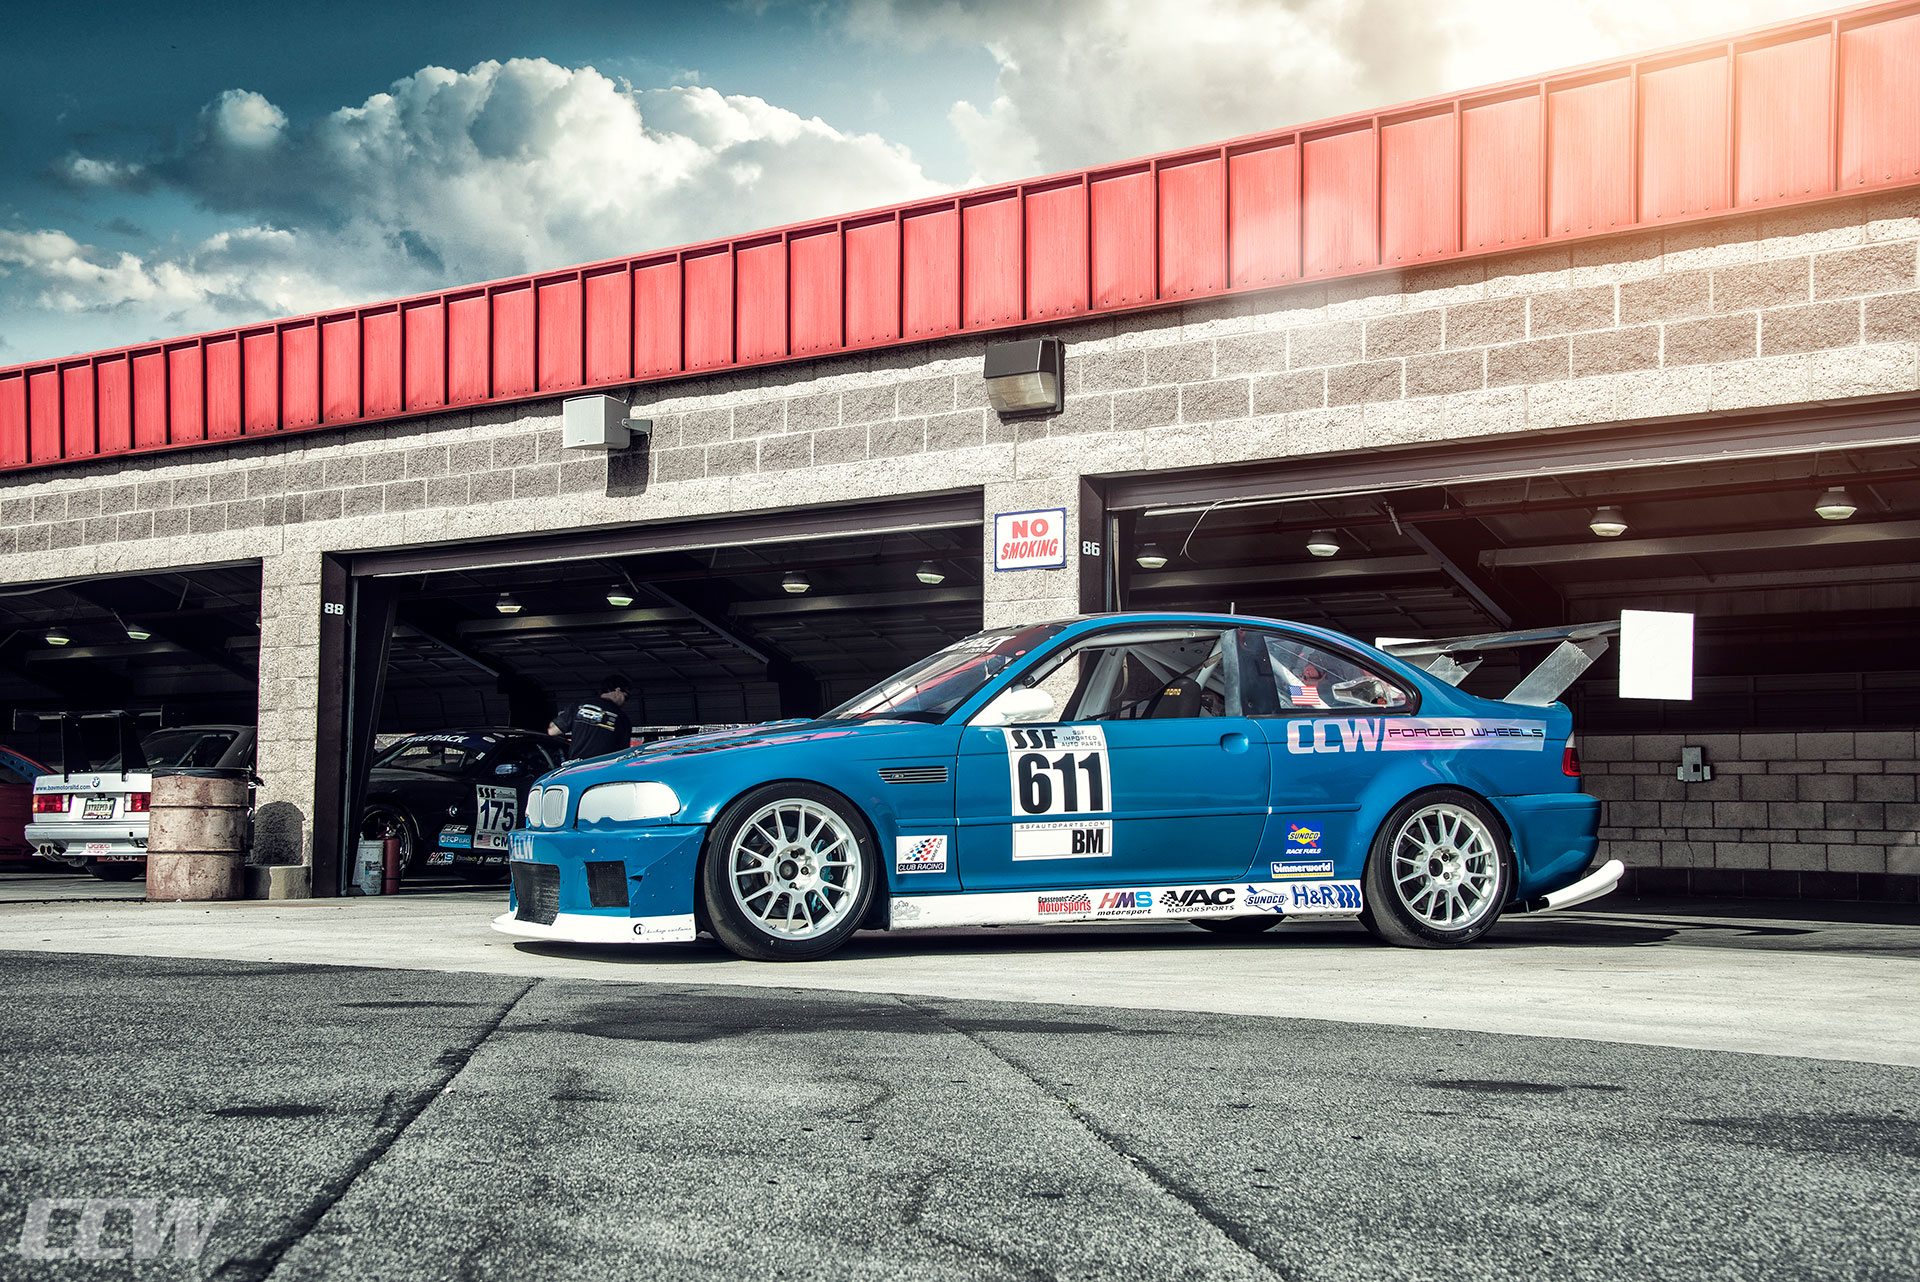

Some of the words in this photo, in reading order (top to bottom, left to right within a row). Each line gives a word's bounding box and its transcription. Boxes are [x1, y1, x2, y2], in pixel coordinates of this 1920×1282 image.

[1012, 518, 1049, 539] NO
[1001, 538, 1059, 560] SMOKING
[1082, 540, 1100, 556] 86
[324, 602, 344, 615] 88
[1011, 729, 1058, 749] SSF
[1287, 718, 1380, 754] CCW
[1387, 728, 1466, 738] FORGED
[1471, 728, 1544, 738] WHEELS
[1018, 752, 1103, 814] 611
[478, 787, 496, 798] SSF
[480, 799, 515, 832] 175
[1020, 821, 1105, 829] SSFAUTOPARTS.COM
[1071, 829, 1104, 854] BM
[1289, 831, 1320, 840] SUNOCO
[898, 863, 916, 871] CLUB
[917, 862, 944, 870] RACING
[1273, 862, 1331, 873] bimmerworld
[1098, 891, 1153, 909] HMS
[1164, 887, 1236, 907] VAC
[1247, 895, 1285, 905] SUNOCO
[1290, 885, 1337, 908] H&R
[1038, 901, 1091, 914] Motorsports
[1097, 908, 1152, 916] motorsport
[1166, 905, 1235, 914] MOTORSPORTS
